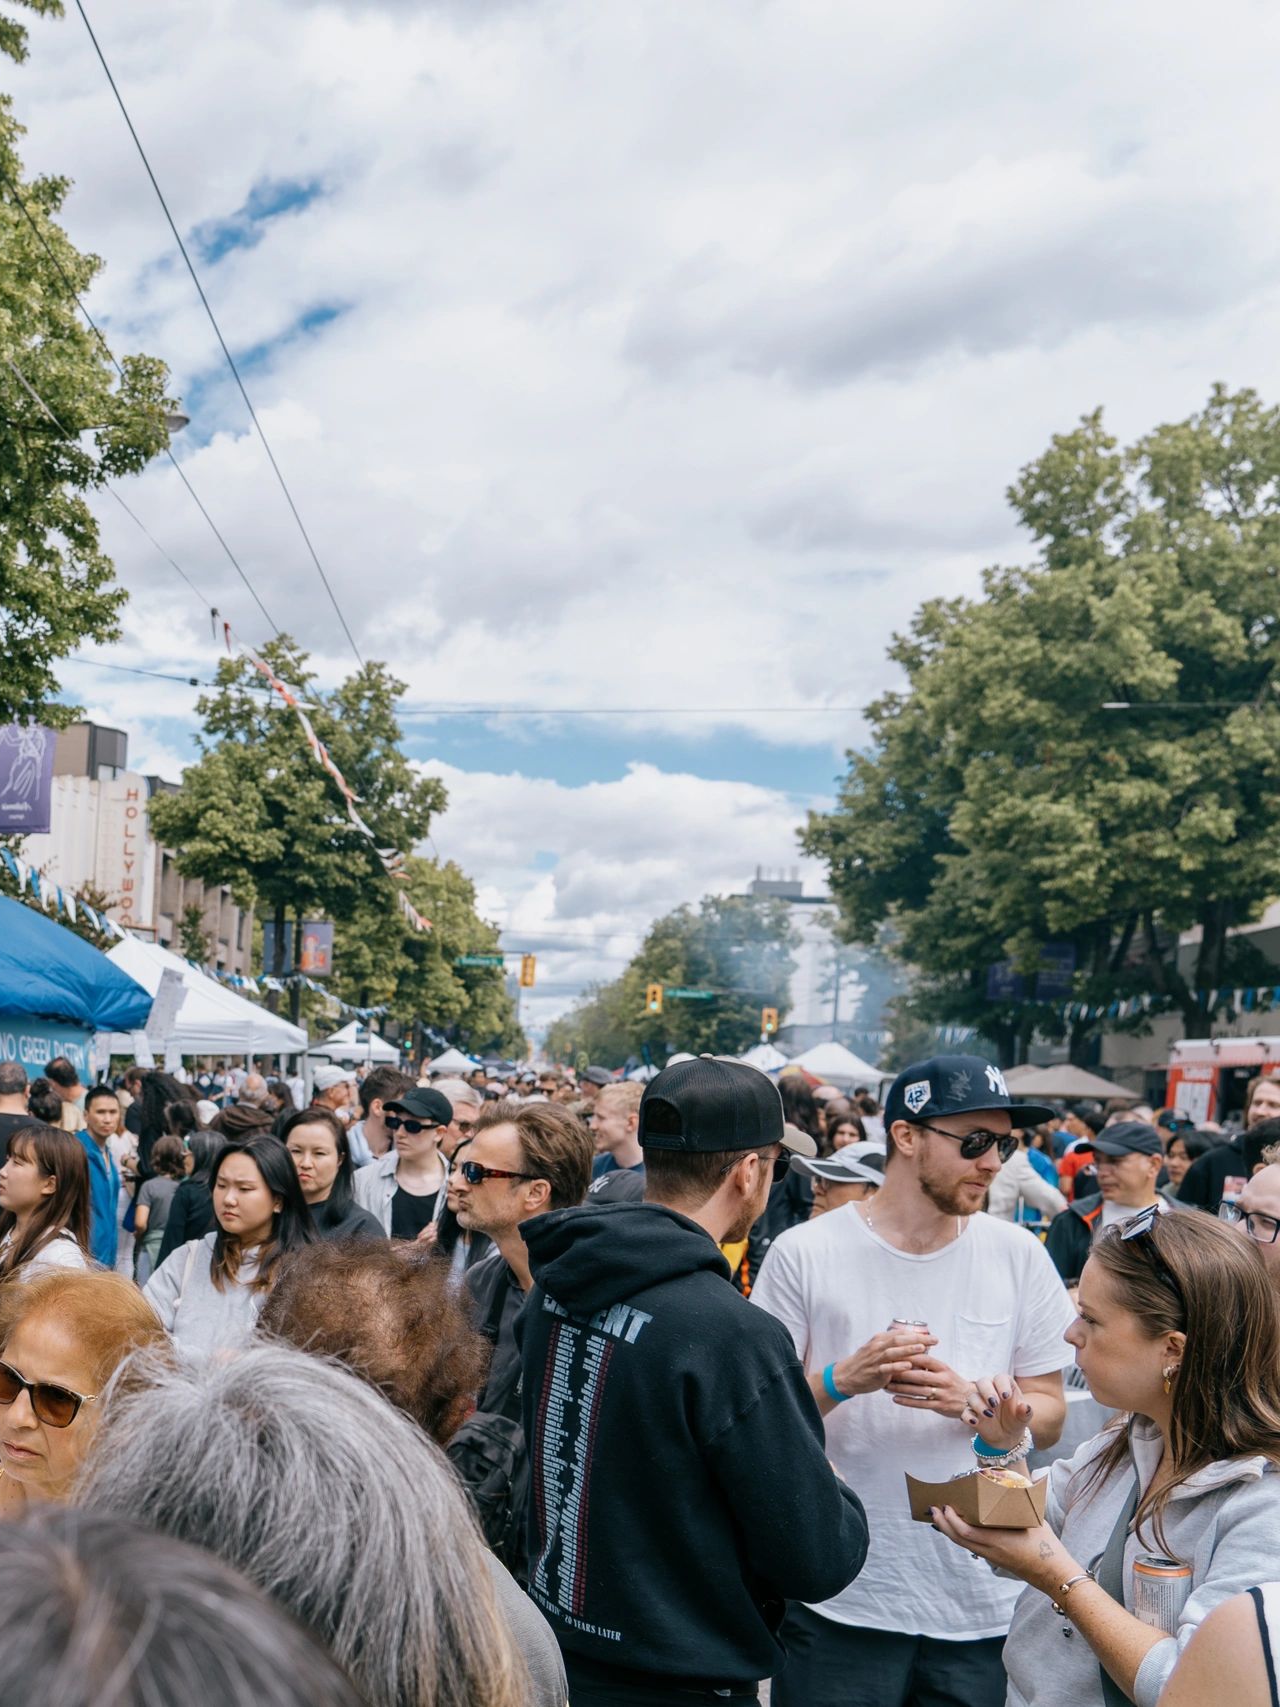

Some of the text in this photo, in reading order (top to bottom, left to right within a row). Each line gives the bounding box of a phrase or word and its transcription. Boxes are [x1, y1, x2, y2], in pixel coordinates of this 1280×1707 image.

[20, 1036, 52, 1065] GREEK
[907, 1090, 925, 1105] 42
[573, 1618, 596, 1634] YEARS
[597, 1626, 621, 1641] LATER
